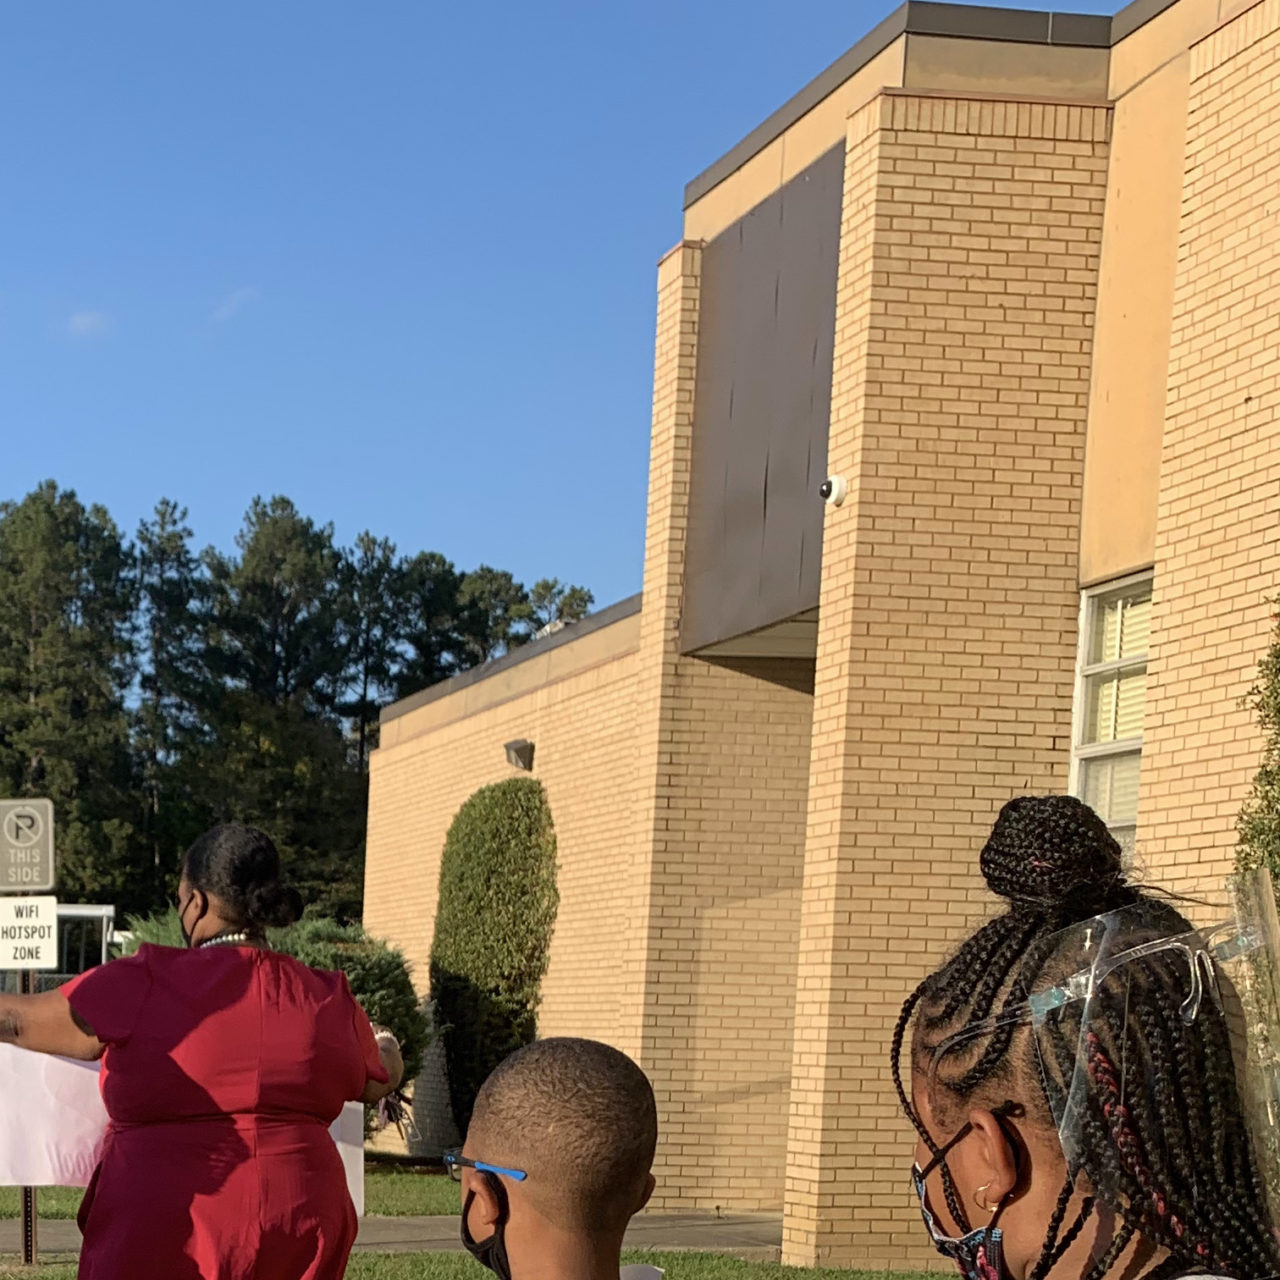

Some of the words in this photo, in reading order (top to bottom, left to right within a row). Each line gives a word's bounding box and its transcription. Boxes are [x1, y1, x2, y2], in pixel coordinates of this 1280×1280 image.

[8, 850, 41, 864] THIS
[8, 867, 41, 882] SIDE
[14, 905, 39, 919] WIFI
[1, 925, 52, 940] HOTSPOT
[13, 946, 41, 960] ZONE
